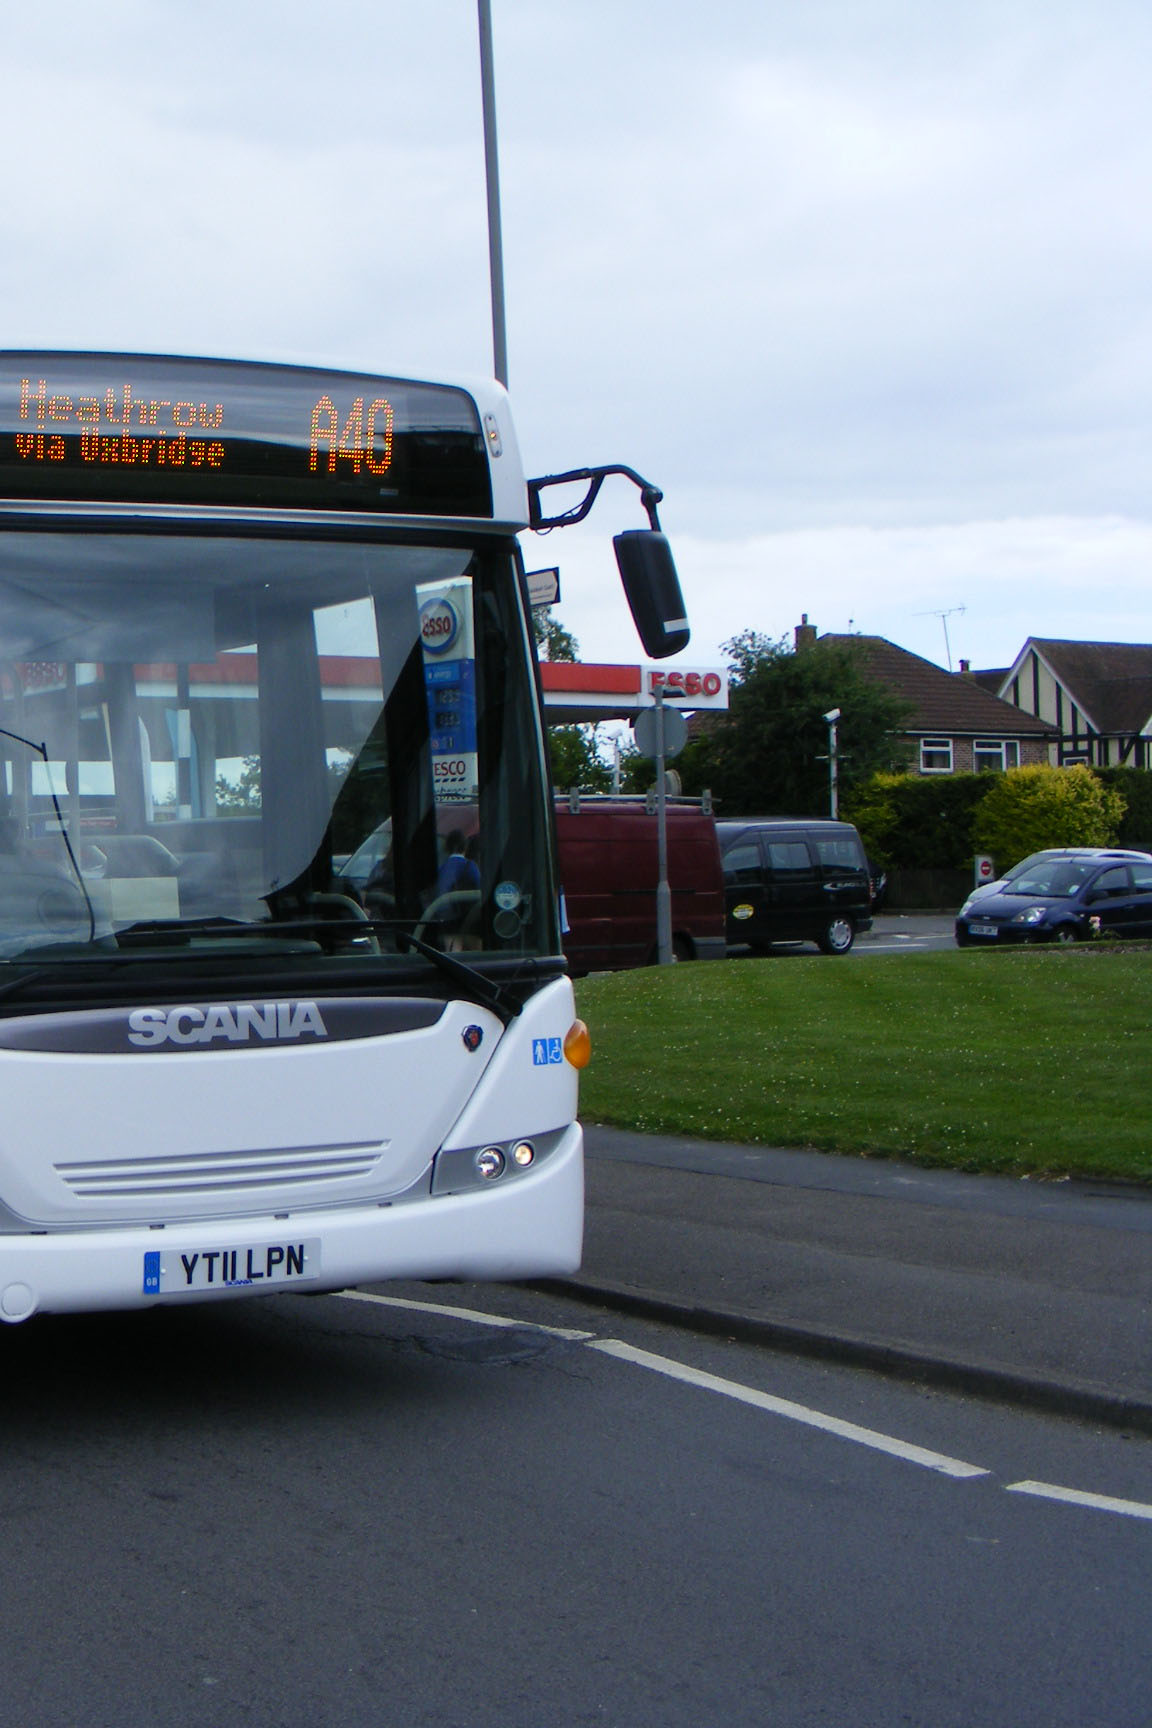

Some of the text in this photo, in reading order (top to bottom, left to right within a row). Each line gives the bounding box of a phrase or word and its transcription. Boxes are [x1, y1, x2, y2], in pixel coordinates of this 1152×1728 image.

[20, 379, 223, 428] Heathrow
[16, 424, 225, 466] via Uxbridge
[309, 395, 394, 474] A40
[433, 761, 466, 776] ESCO
[128, 1002, 328, 1046] SCANIA
[181, 1244, 305, 1285] YT11 LPN
